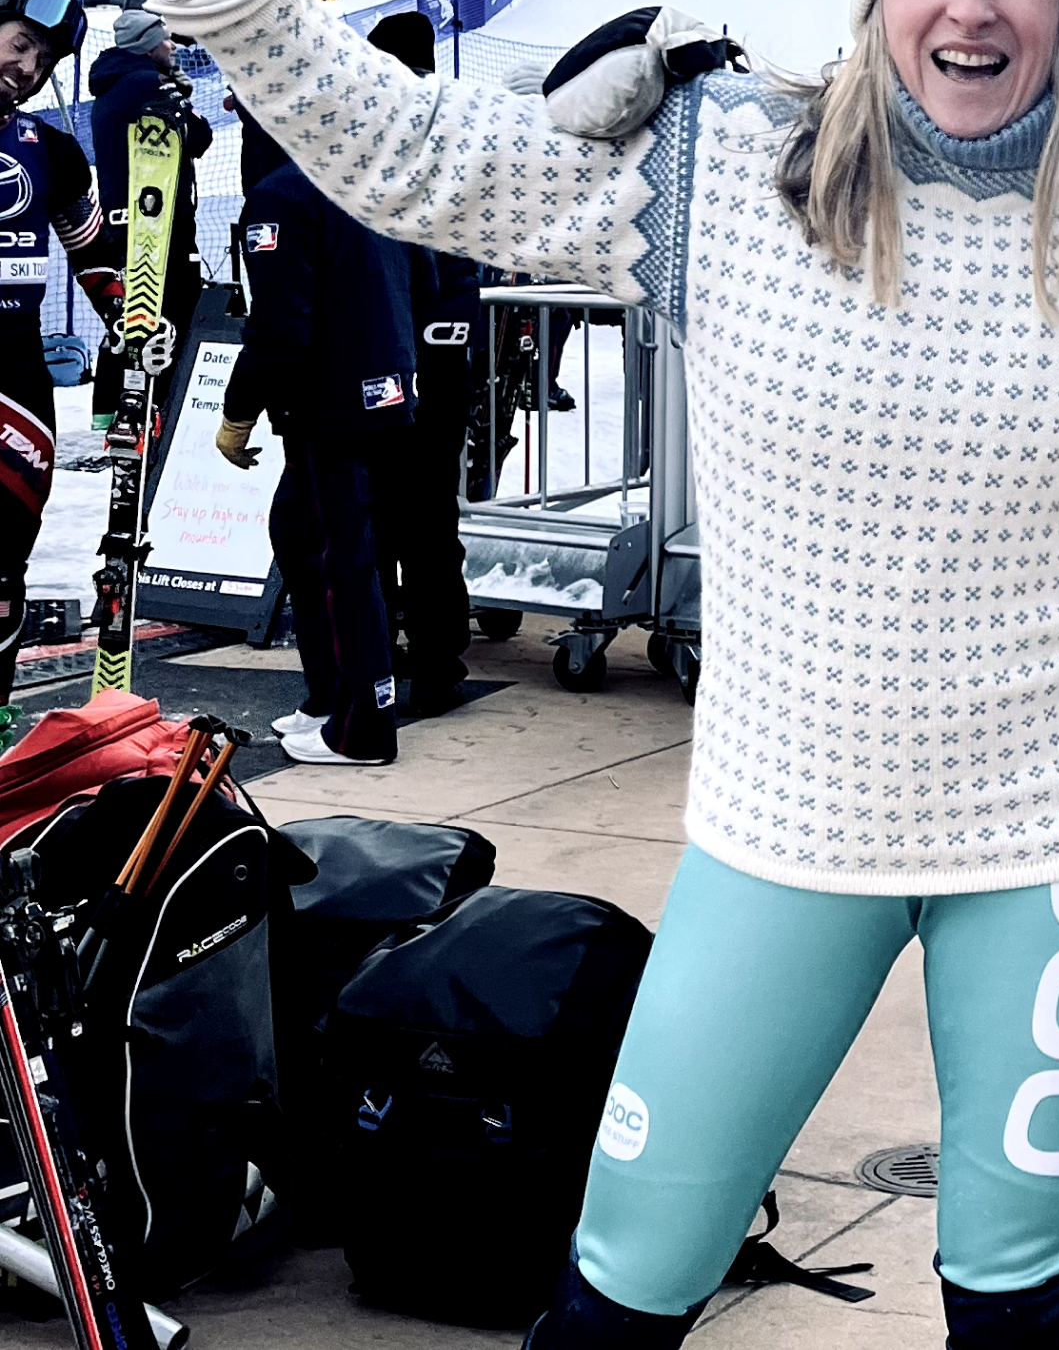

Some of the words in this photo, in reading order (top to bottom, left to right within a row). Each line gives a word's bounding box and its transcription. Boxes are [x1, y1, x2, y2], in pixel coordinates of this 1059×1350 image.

[10, 263, 29, 277] SKI
[423, 322, 470, 345] CB
[202, 351, 232, 364] Date:
[198, 374, 227, 387] Time:
[191, 397, 224, 412] Temp:
[192, 508, 208, 526] up
[137, 570, 152, 584] his
[151, 573, 170, 587] Lift
[170, 576, 204, 590] Closes
[204, 580, 217, 592] at
